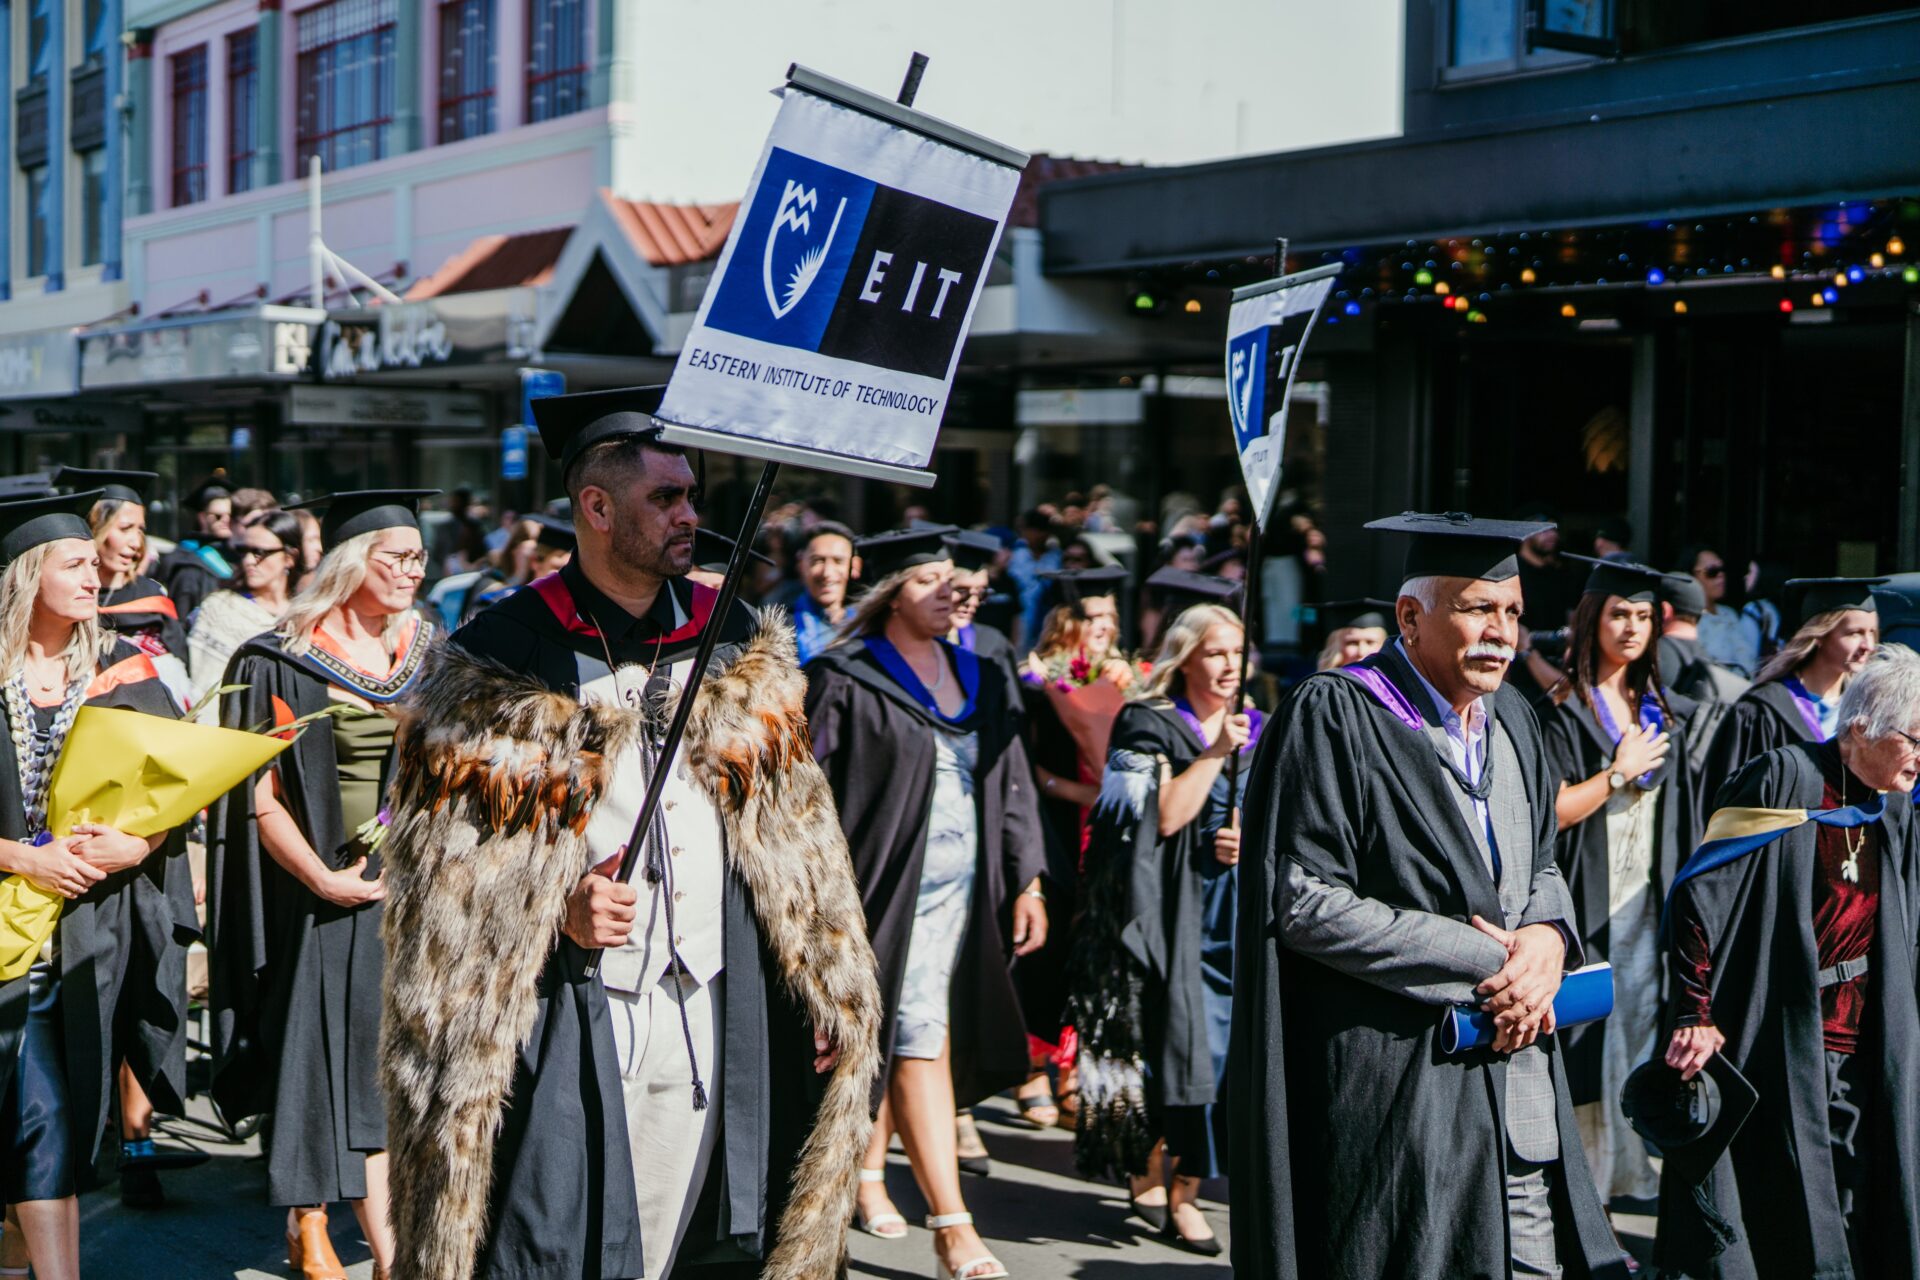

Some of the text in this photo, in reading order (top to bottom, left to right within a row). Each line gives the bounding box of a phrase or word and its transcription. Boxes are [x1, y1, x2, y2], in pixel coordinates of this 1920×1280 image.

[859, 249, 962, 320] EIT
[689, 348, 939, 416] EASTERN INSTITUTE OF TECHNOLOGY
